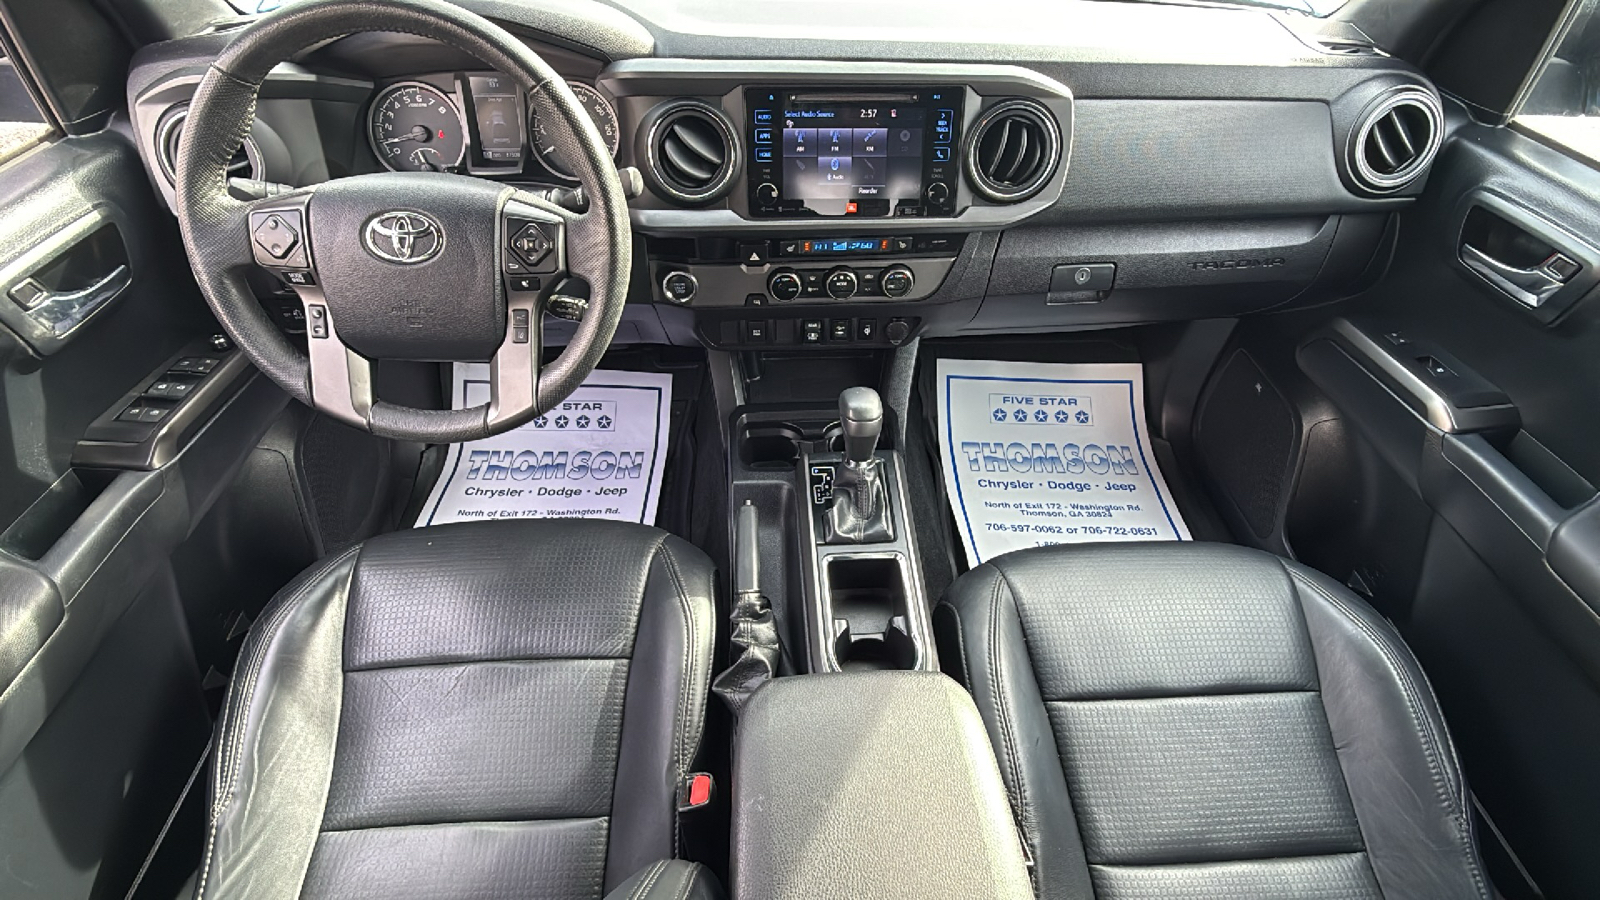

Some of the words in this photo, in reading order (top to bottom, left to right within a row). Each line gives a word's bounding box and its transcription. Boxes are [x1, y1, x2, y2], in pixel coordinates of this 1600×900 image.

[860, 108, 878, 118] 2:57
[1186, 257, 1286, 270] TACOMA
[562, 402, 603, 411] STAR
[1002, 396, 1034, 405] FIVE
[1039, 397, 1078, 406] STAR
[961, 441, 1140, 475] THOMSON
[466, 450, 645, 481] THOMSON
[977, 478, 1034, 491] Chrysler
[1047, 481, 1092, 493] Dodge
[1104, 481, 1137, 493] Jeep
[464, 486, 525, 499] Chrysler
[537, 486, 583, 499] Dodge
[594, 486, 628, 497] Jeep
[457, 509, 485, 517] North
[486, 509, 498, 517] of
[521, 509, 538, 517] 172
[604, 507, 621, 515] Rd.
[984, 501, 1011, 509] North
[1046, 502, 1063, 510] 172
[1069, 502, 1125, 512] Washington
[1019, 509, 1067, 518] Thomson,
[1068, 510, 1084, 518] GA
[985, 522, 1064, 534] 706-597-0062
[1080, 526, 1158, 536] 706-722-0631
